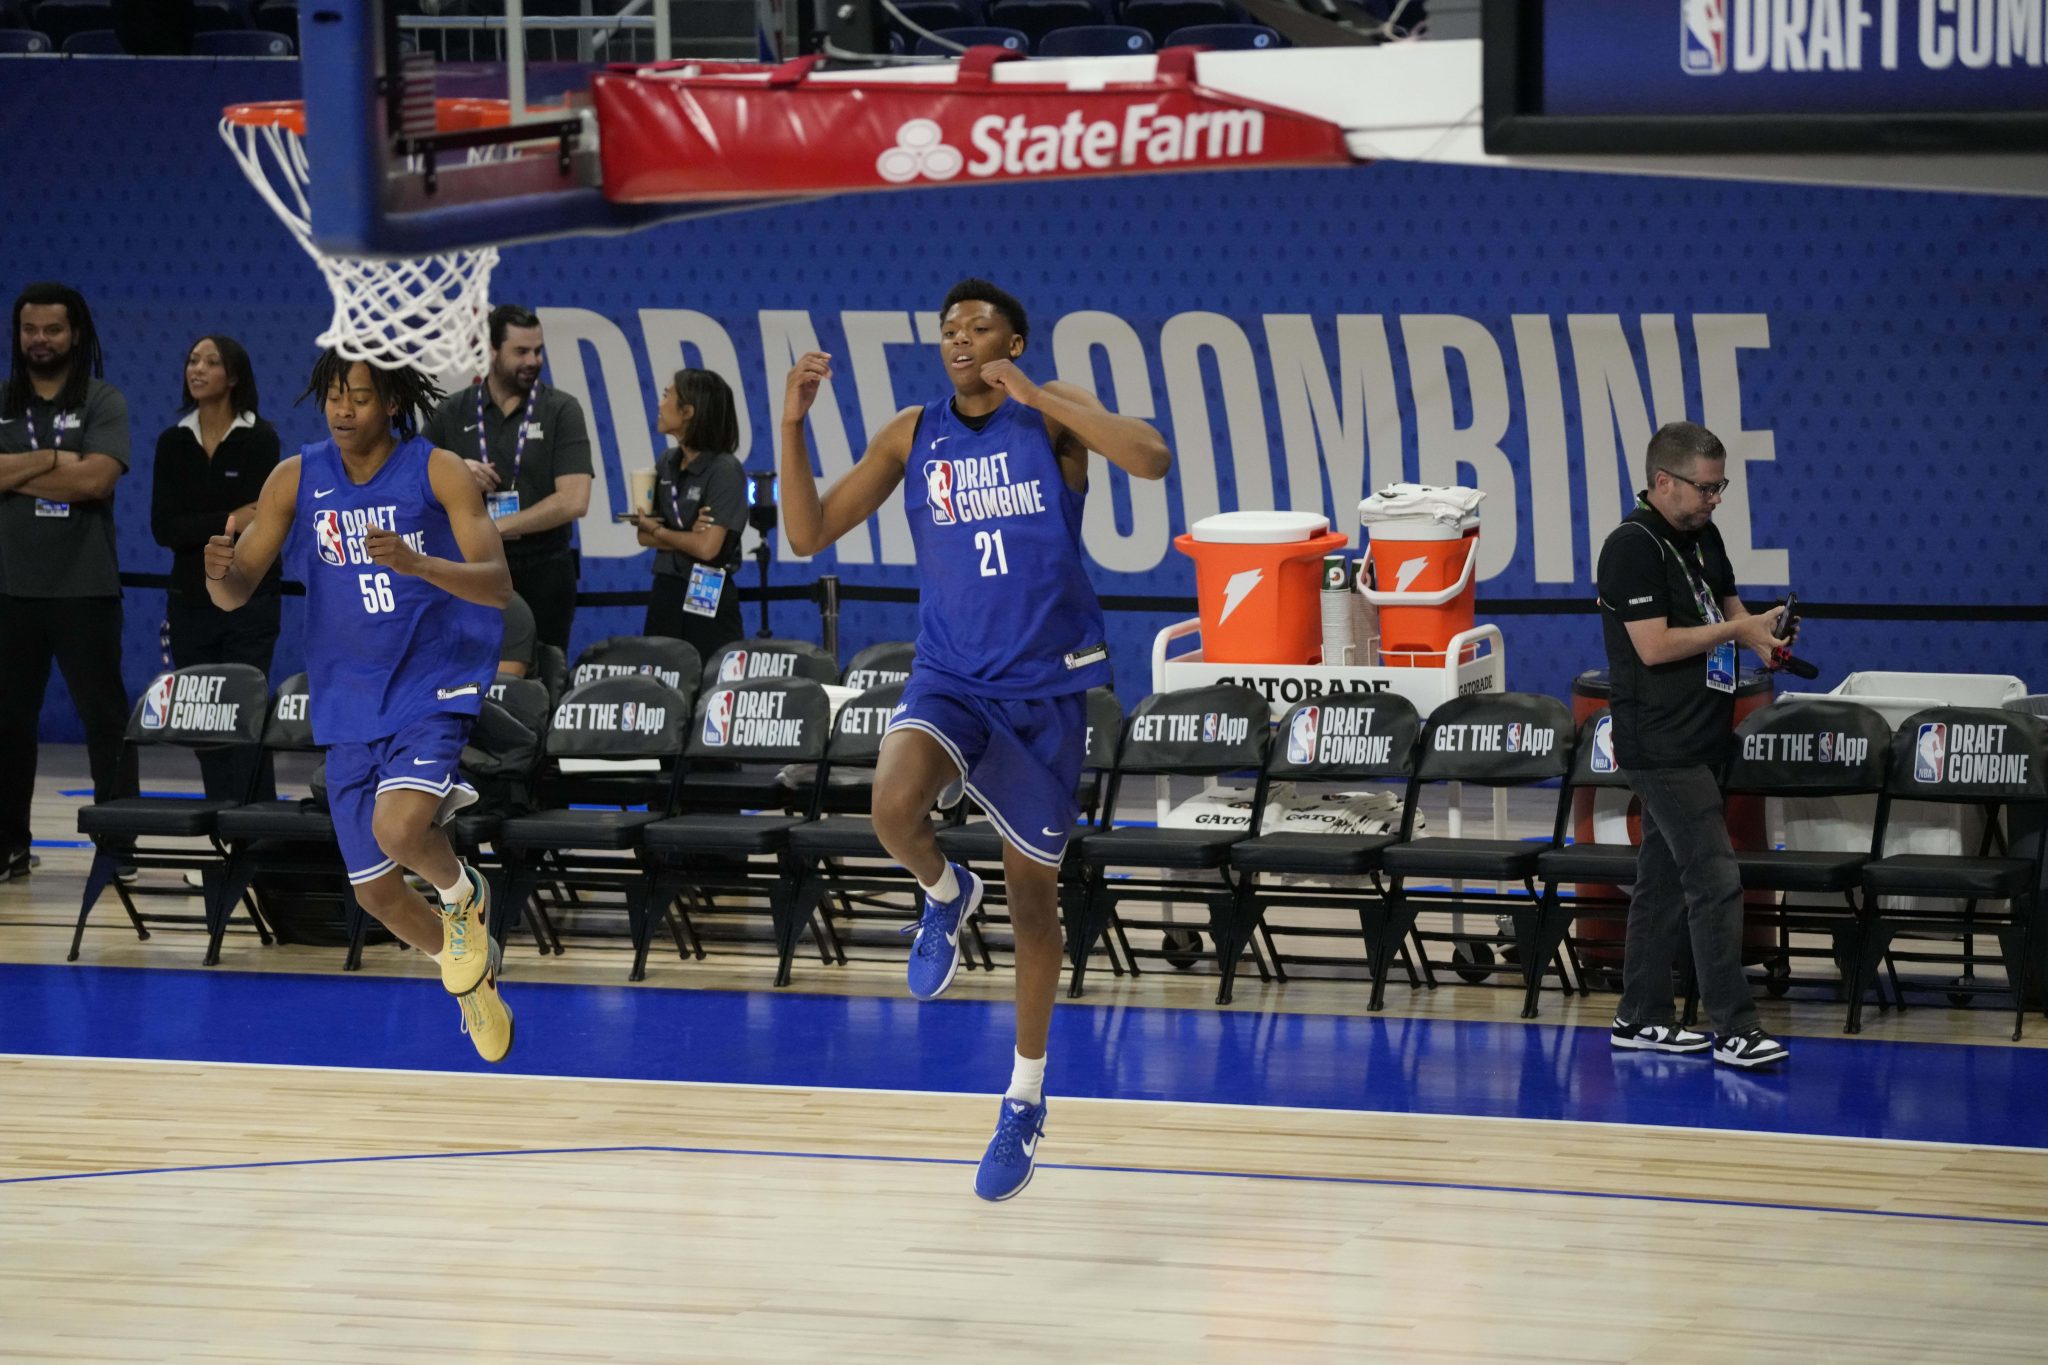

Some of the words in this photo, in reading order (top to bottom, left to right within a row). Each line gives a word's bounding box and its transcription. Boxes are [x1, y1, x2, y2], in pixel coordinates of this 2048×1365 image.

[1052, 310, 1790, 586] COMBINE
[954, 452, 1009, 490] DRAFT
[956, 480, 1045, 522] COMBINE
[974, 529, 1008, 577] 21
[358, 573, 395, 613] 56
[748, 652, 797, 677] DRAFT
[175, 675, 226, 703] DRAFT
[1459, 675, 1492, 697] GATORADE
[171, 702, 239, 731] COMBINE
[278, 694, 309, 720] GET
[554, 703, 586, 730] GET
[589, 704, 619, 730] THE
[635, 702, 665, 735] App
[736, 691, 787, 719] DRAFT
[732, 718, 803, 746] COMBINE
[841, 707, 873, 734] GET
[1133, 714, 1165, 742] GET
[1168, 715, 1200, 742] THE
[1216, 713, 1249, 746] App
[1322, 707, 1375, 736] DRAFT
[1319, 735, 1393, 764] COMBINE
[1434, 724, 1467, 752] GET
[1471, 725, 1503, 752] THE
[1521, 723, 1554, 756] App
[1742, 733, 1777, 761] GET
[1780, 734, 1814, 761] THE
[1834, 732, 1868, 767] App
[1950, 724, 2007, 754] DRAFT
[1948, 753, 2029, 784] COMBINE
[1195, 814, 1252, 826] GATO
